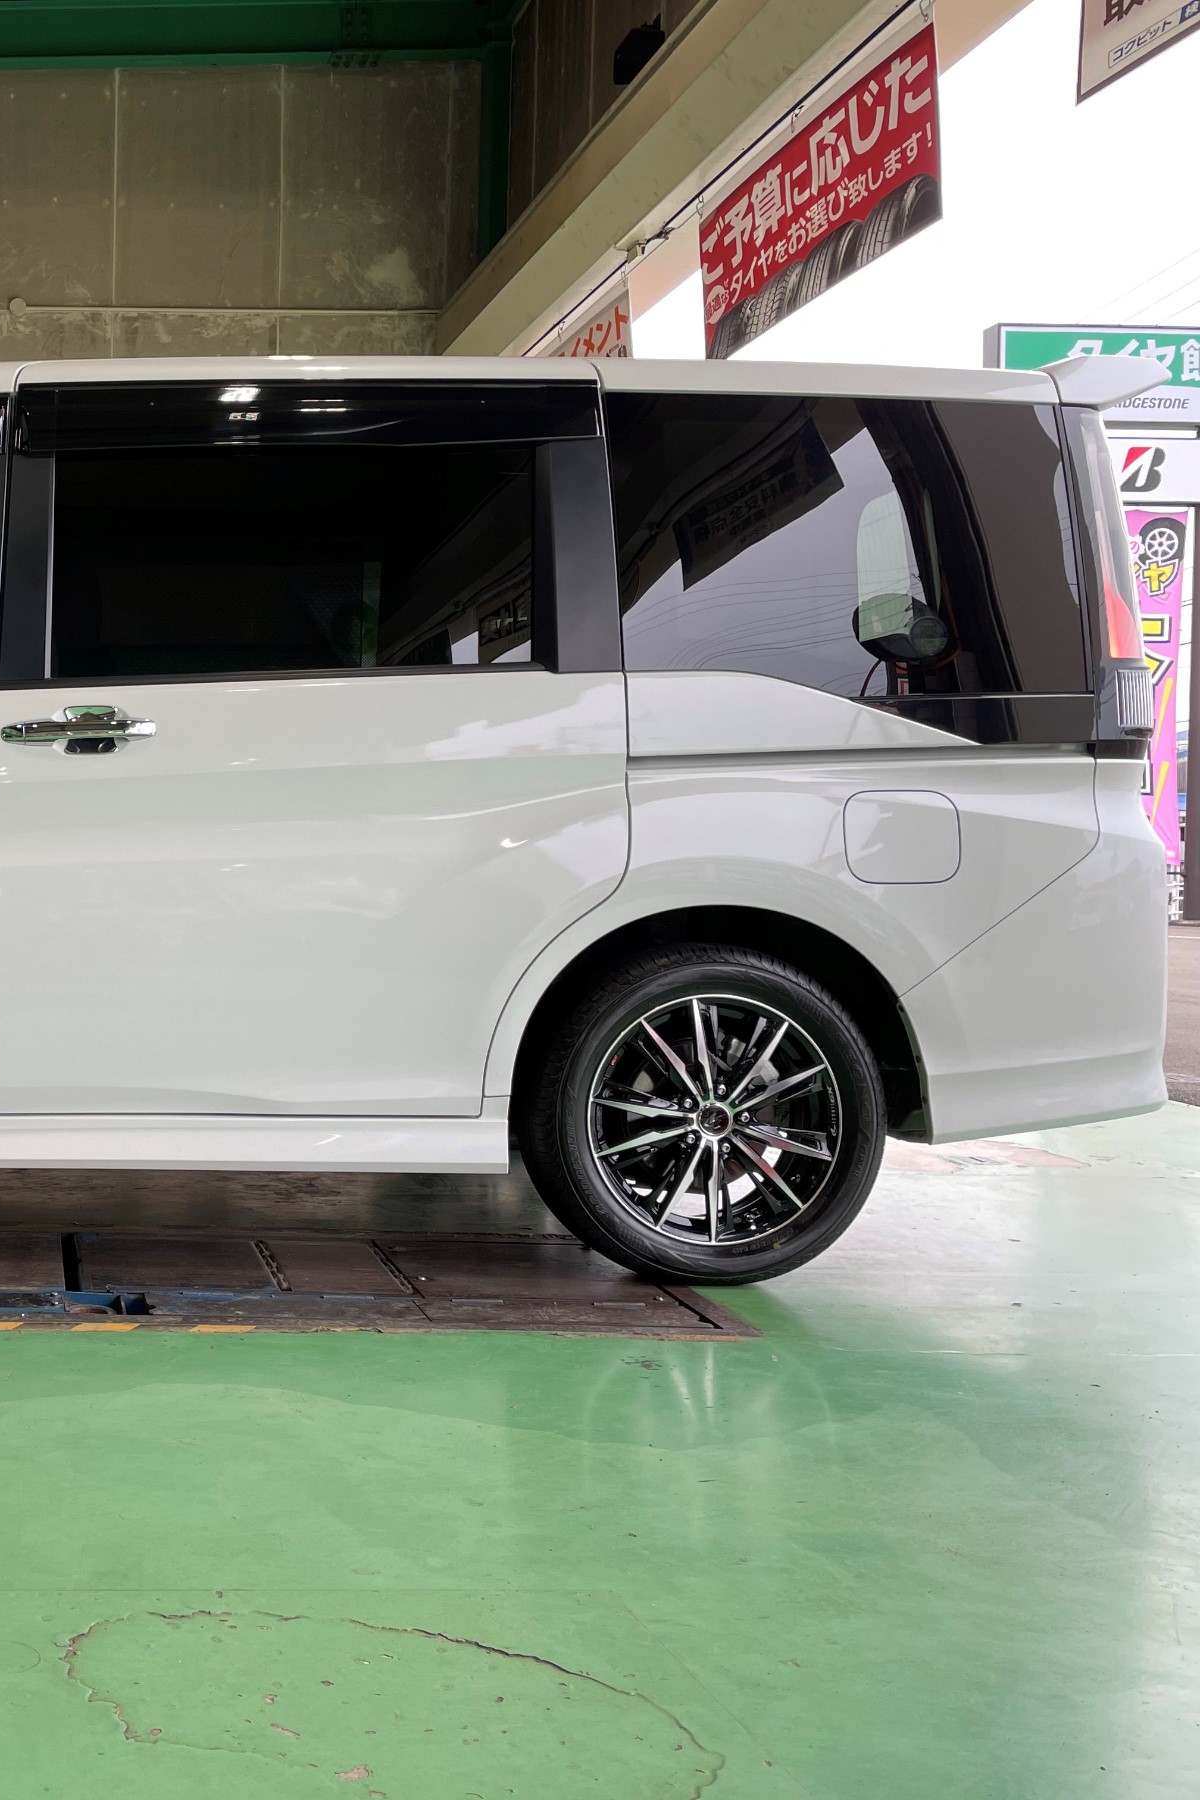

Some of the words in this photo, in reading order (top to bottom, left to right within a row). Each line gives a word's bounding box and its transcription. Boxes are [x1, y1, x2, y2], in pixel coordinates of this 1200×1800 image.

[1113, 20, 1172, 62] コクピット
[702, 54, 932, 284] ご予算に応じた
[730, 122, 933, 305] タイヤをお選び致します!
